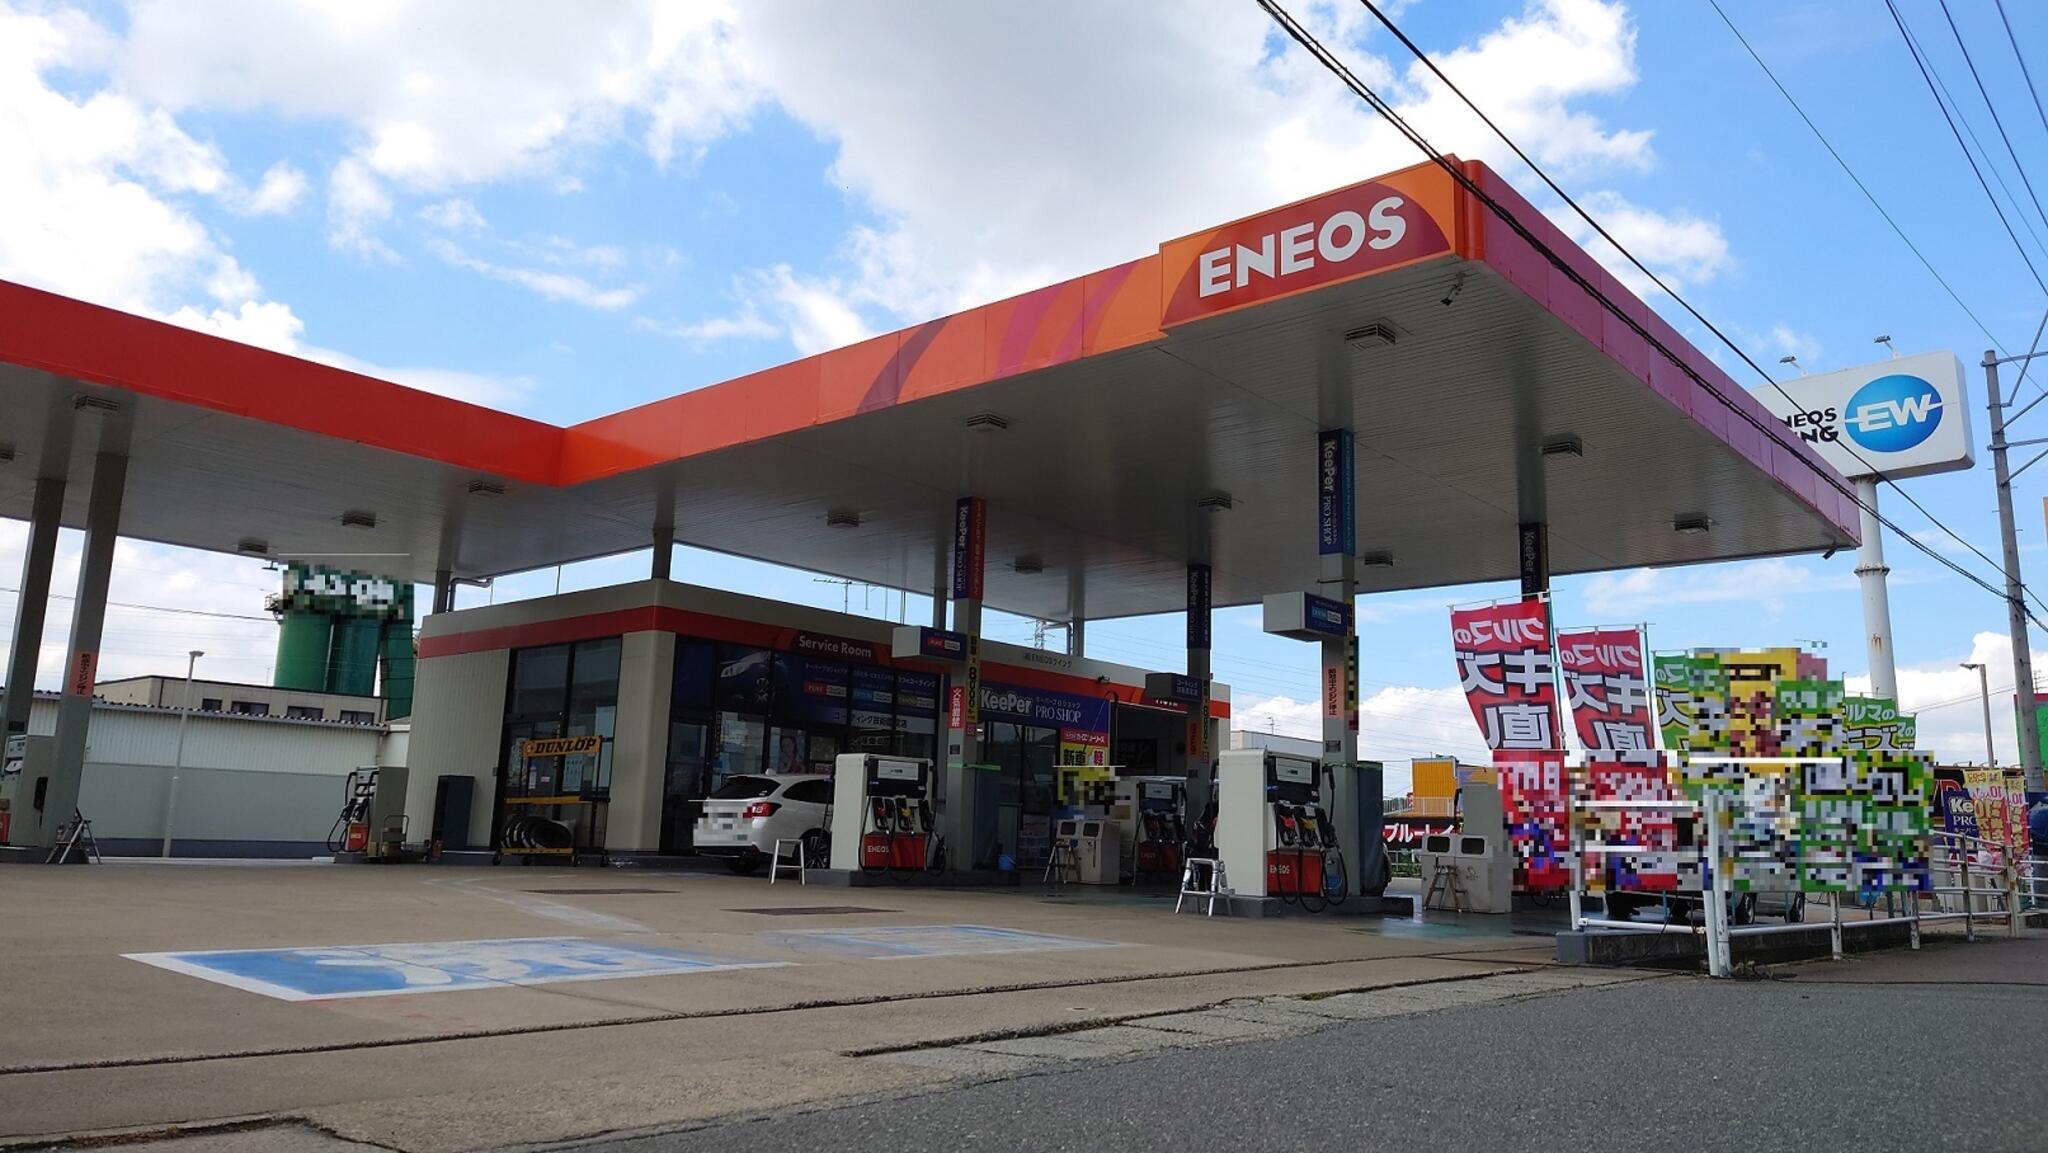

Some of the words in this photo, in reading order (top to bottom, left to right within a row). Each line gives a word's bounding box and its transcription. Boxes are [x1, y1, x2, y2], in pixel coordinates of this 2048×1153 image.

[1199, 196, 1406, 298] ENEOS
[1856, 393, 1932, 433] EW
[1323, 440, 1336, 491] KeePer
[799, 635, 839, 653] Service
[841, 642, 872, 659] Room
[980, 688, 1033, 714] KeePer
[1846, 703, 1897, 722] ルマの
[1036, 705, 1055, 719] PRO
[1055, 706, 1082, 724] SHOP
[535, 738, 597, 755] DUNLOP
